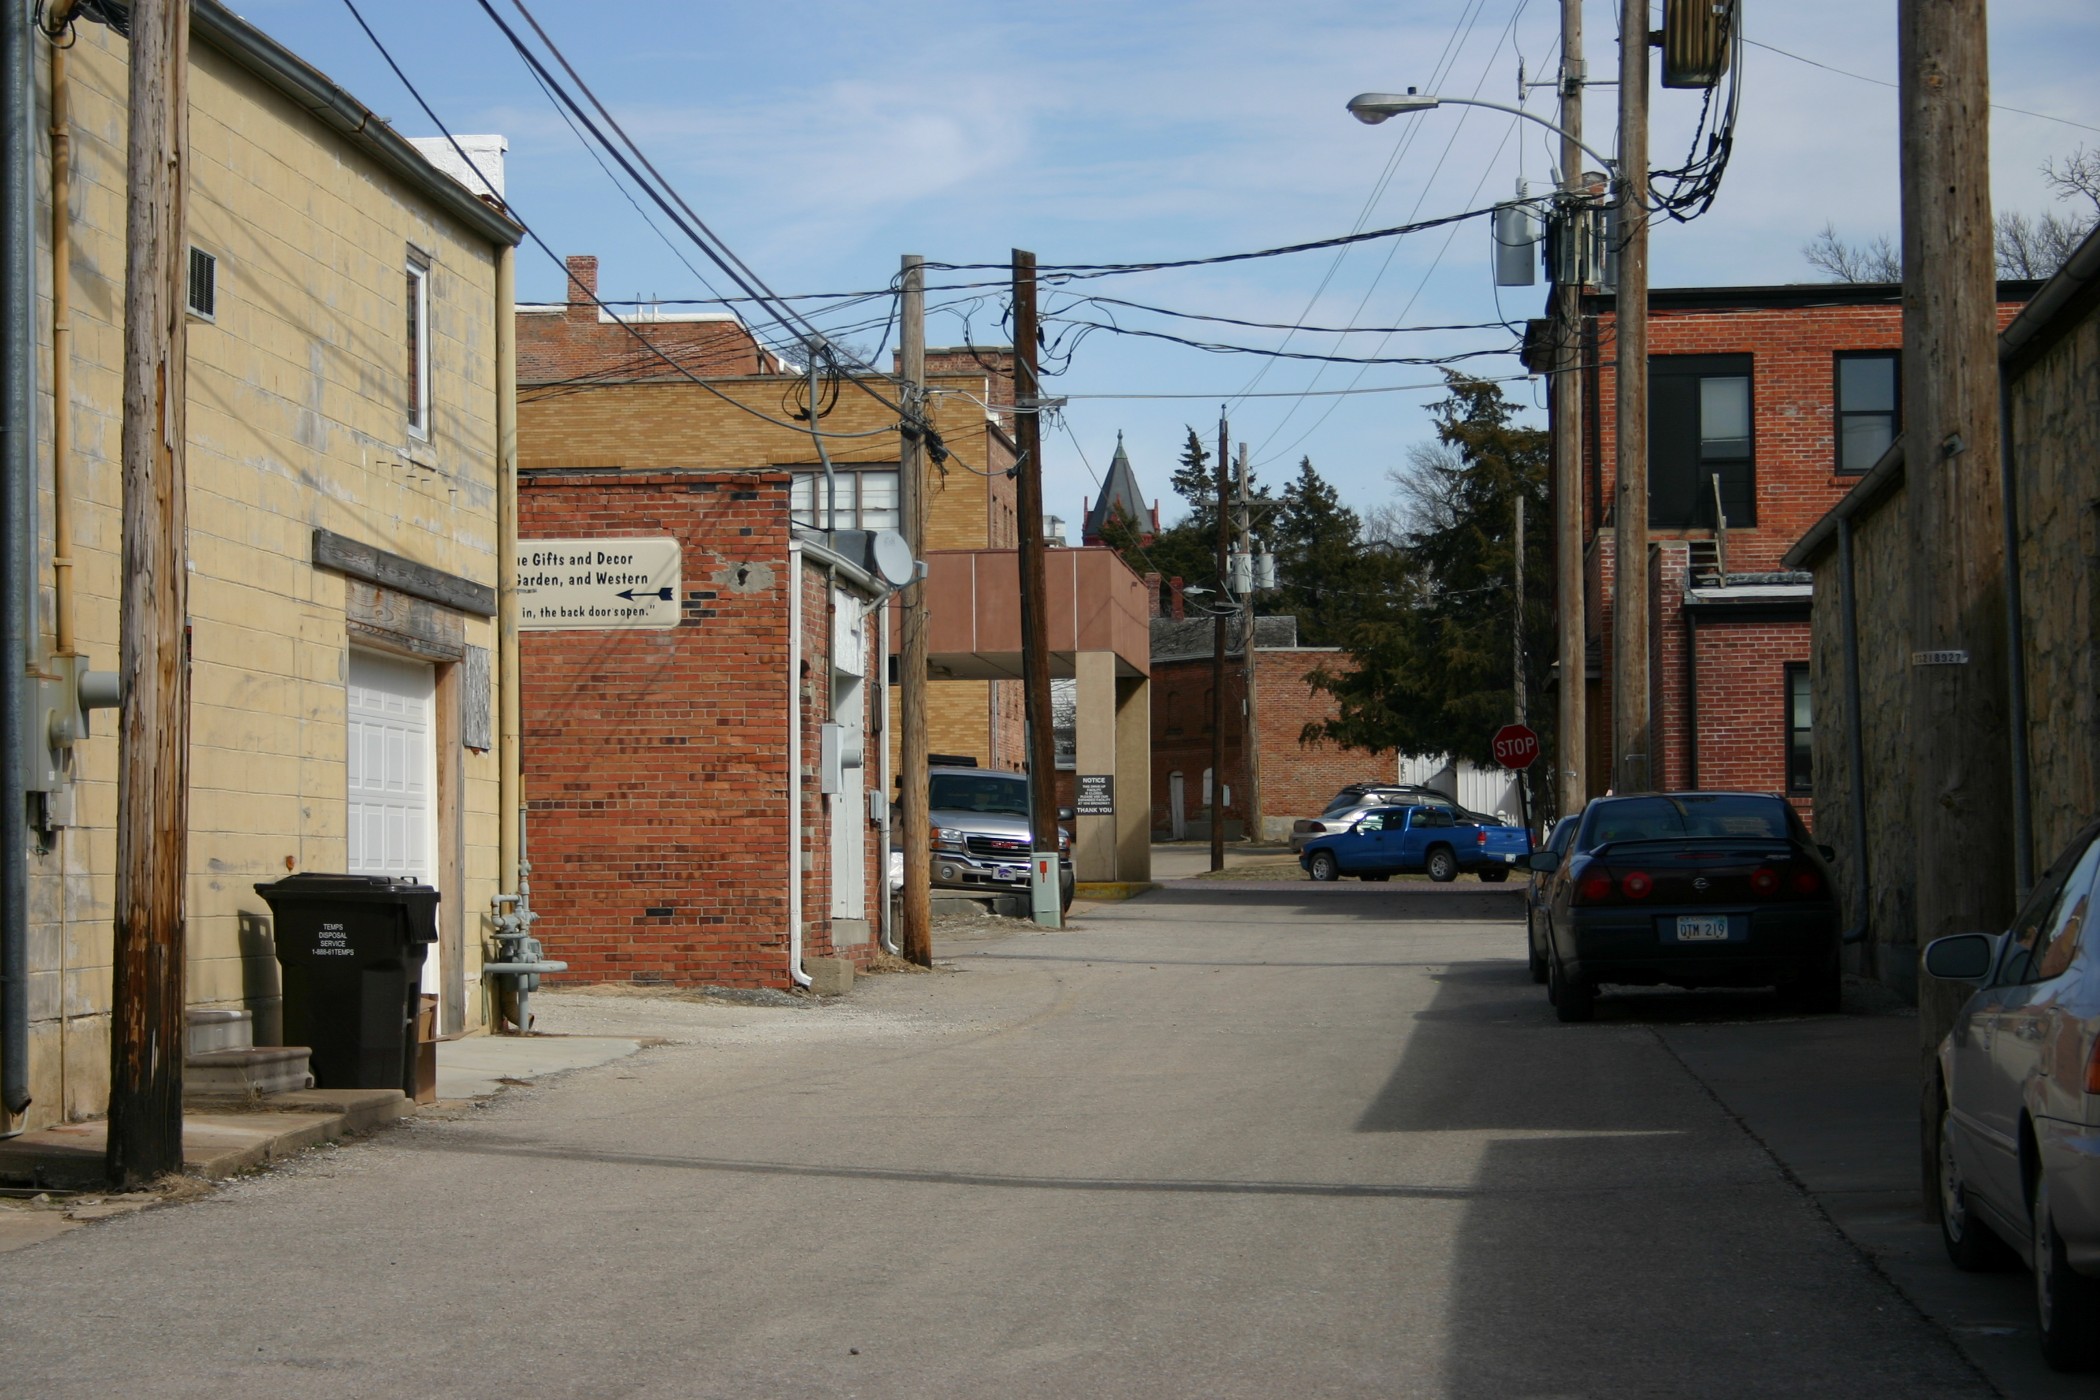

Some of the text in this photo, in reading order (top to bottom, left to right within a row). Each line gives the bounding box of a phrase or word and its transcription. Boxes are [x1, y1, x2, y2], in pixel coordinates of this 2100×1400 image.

[532, 552, 565, 567] Gifts
[569, 551, 592, 566] and
[597, 551, 633, 566] Decor
[568, 571, 591, 585] and
[596, 571, 648, 585] Western
[522, 607, 536, 619] in,
[540, 606, 557, 618] the
[560, 606, 585, 618] back
[588, 605, 619, 617] door's
[1496, 737, 1535, 757] STOP
[323, 923, 344, 931] TEMPS
[1705, 923, 1725, 936] 219
[318, 931, 348, 939] DISPOSAL
[320, 940, 346, 948] SERVICE
